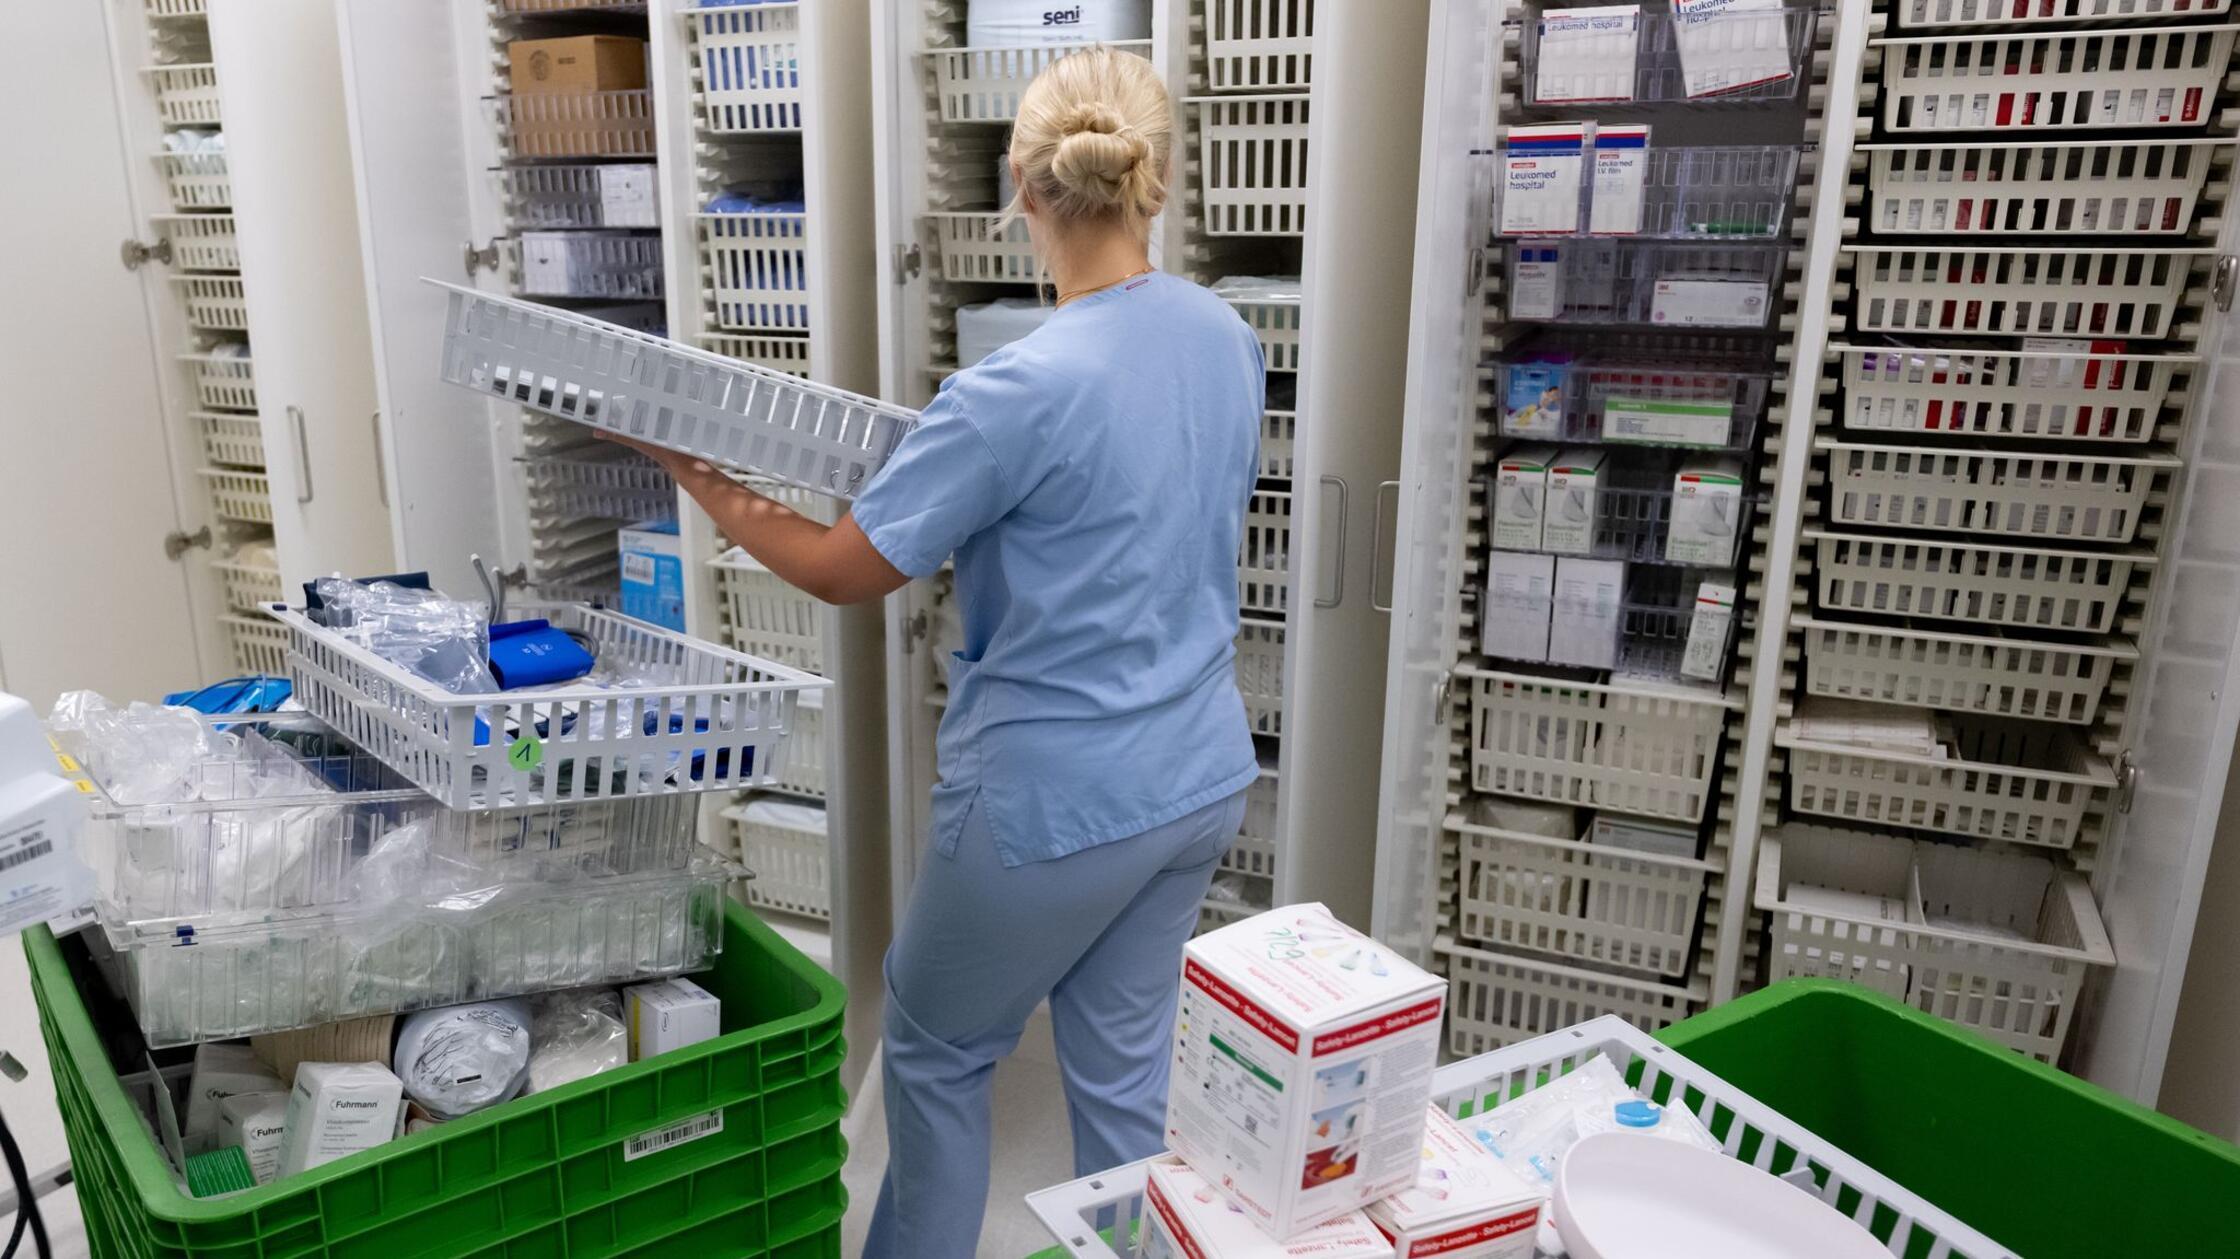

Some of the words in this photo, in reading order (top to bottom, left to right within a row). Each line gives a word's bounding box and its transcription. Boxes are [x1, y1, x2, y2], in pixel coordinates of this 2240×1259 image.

[1683, 0, 1735, 13] Leukome
[1043, 5, 1080, 25] seni
[1598, 160, 1633, 168] Leukomed
[1510, 170, 1556, 181] Leukomed
[1509, 180, 1545, 191] hospital
[516, 743, 531, 762] 1
[1187, 963, 1241, 1009] Safety-Lancette
[1243, 1003, 1297, 1048] Safety-Lancet
[1314, 1022, 1381, 1050] Safety-Lancette
[1384, 1004, 1438, 1030] Safety-Lancet
[335, 1099, 378, 1109] Fuhrmann
[256, 1126, 284, 1137] Fuhrm
[1412, 1230, 1479, 1254] Safety-Lancette
[1482, 1213, 1537, 1236] Safety-Lancet
